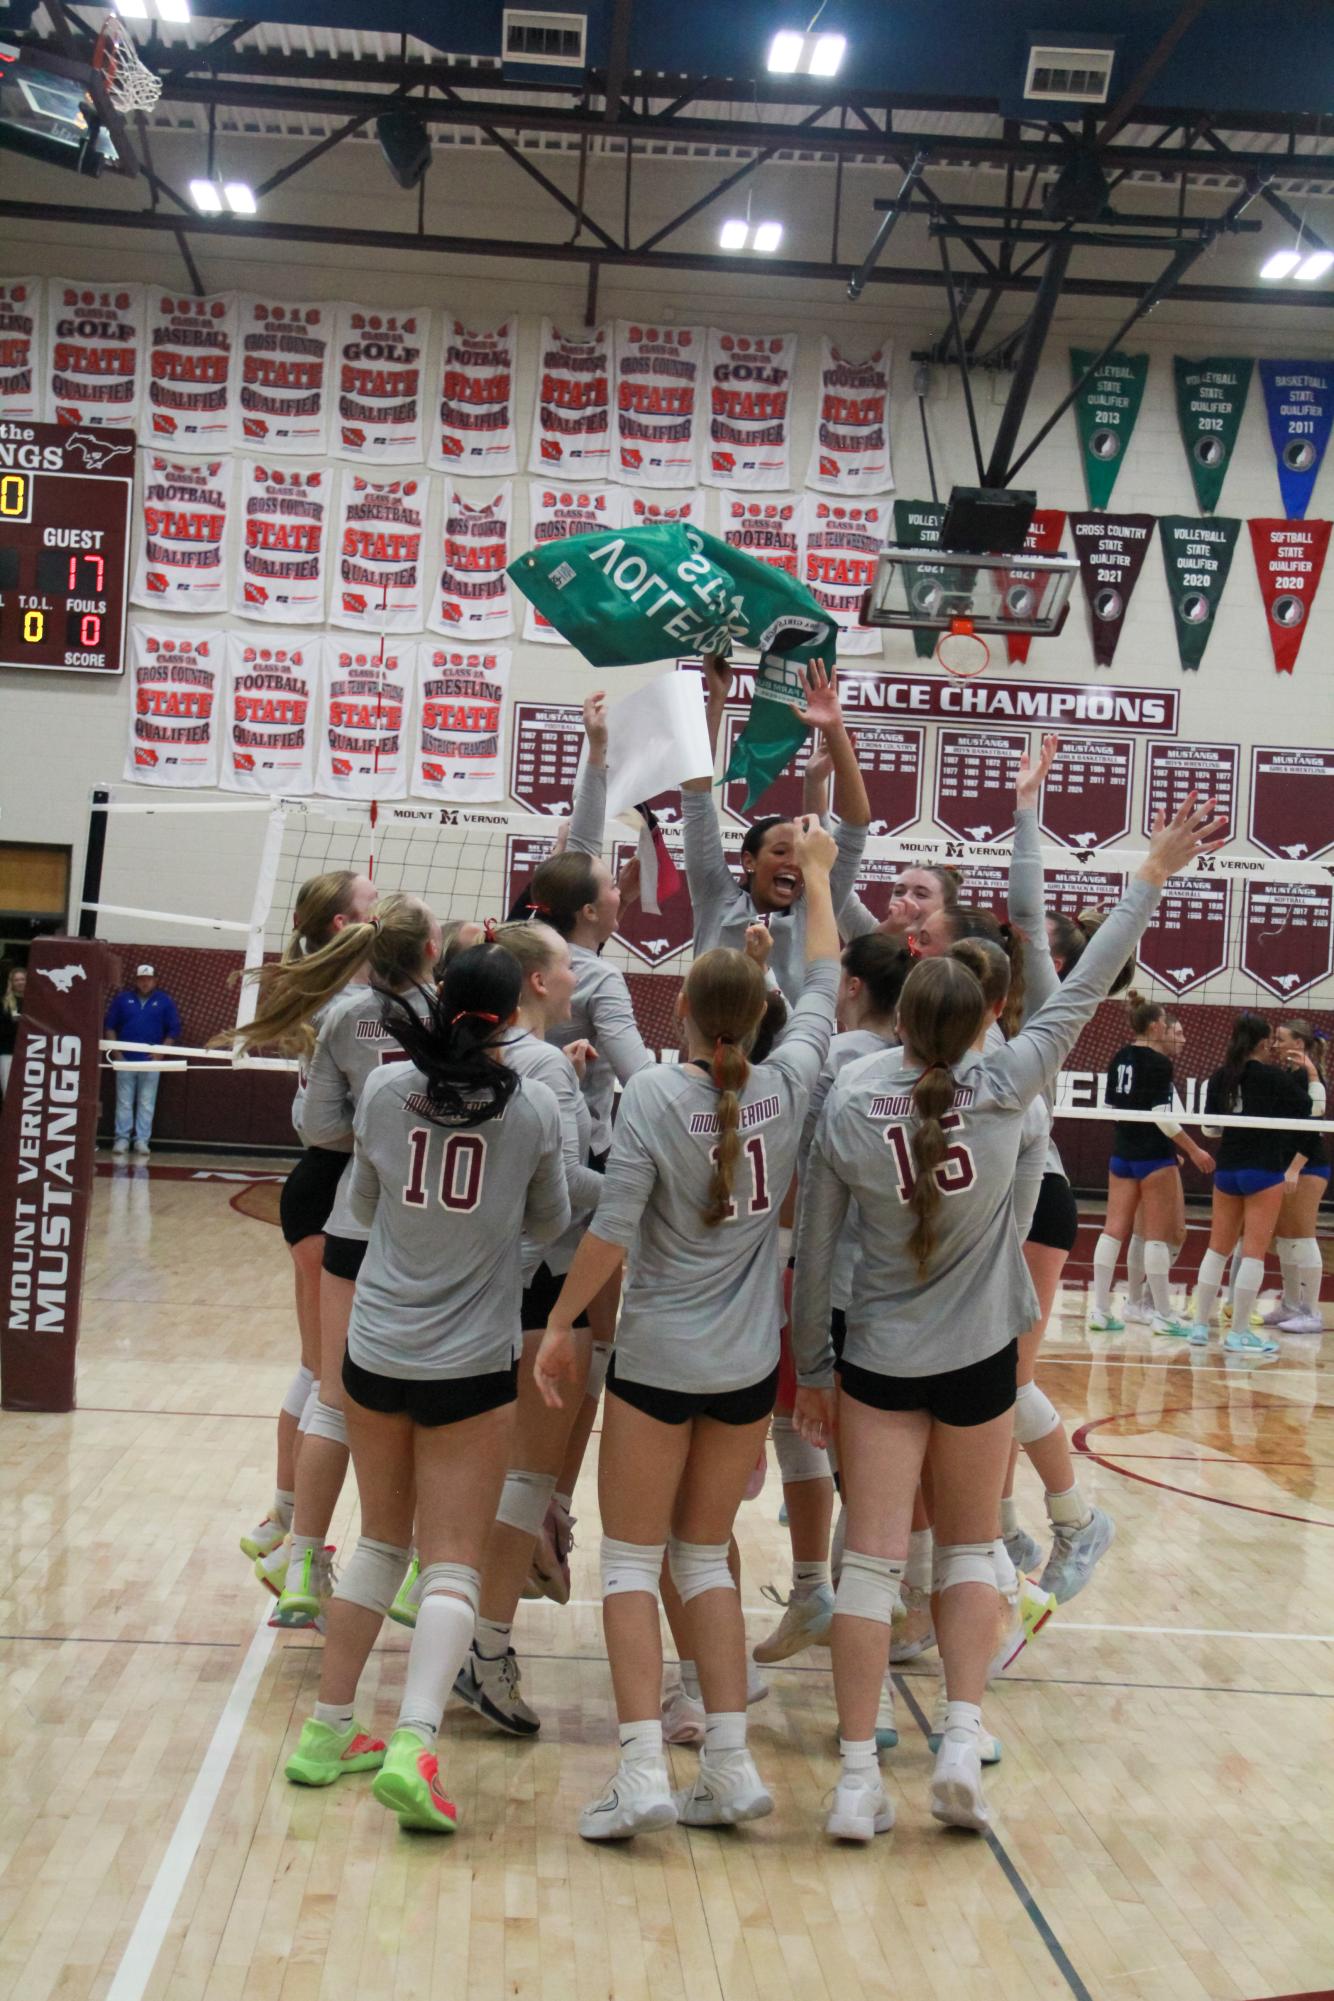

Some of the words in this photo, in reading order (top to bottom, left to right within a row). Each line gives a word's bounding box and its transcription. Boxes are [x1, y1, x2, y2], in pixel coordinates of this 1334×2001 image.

[56, 320, 136, 342] GOLF
[152, 328, 231, 353] BASEBALL
[54, 343, 136, 376] STATE
[342, 343, 420, 365] GOLF
[151, 351, 229, 383] STATE
[243, 355, 323, 389] STATE
[713, 364, 788, 386] GOLF
[52, 374, 135, 403] QUALIFIER
[340, 364, 419, 397] STATE
[443, 371, 511, 405] STATE
[1097, 381, 1121, 393] STATE
[1275, 376, 1328, 388] BASKETBALL
[150, 380, 227, 411] QUALIFIER
[240, 386, 320, 416] QUALIFIER
[541, 373, 608, 411] STATE
[618, 380, 695, 417] STATE
[1088, 395, 1129, 407] QUALIFIER
[1199, 387, 1224, 399] STATE
[1289, 391, 1314, 403] STATE
[339, 395, 417, 424] QUALIFIER
[711, 386, 788, 421] STATE
[822, 394, 885, 425] STATE
[1190, 401, 1232, 413] QUALIFIER
[1280, 404, 1322, 417] QUALIFIER
[540, 404, 608, 434] QUALIFIER
[1095, 411, 1120, 424] 2013
[1198, 418, 1223, 431] 2012
[1288, 421, 1314, 434] 2011
[0, 424, 35, 440] the
[618, 413, 692, 443] QUALIFIER
[710, 418, 784, 447] QUALIFIER
[147, 485, 226, 510] FOOTBALL
[543, 491, 606, 510] 2021
[346, 504, 422, 528] BASKETBALL
[554, 509, 582, 519] CLASS
[144, 507, 225, 543] STATE
[534, 521, 566, 540] CROSS
[742, 519, 767, 530] CLASS
[826, 520, 852, 531] CLASS
[1076, 524, 1105, 536] CROSS
[1107, 525, 1146, 539] COUNTRY
[43, 528, 104, 549] GUEST
[246, 519, 322, 554] STATE
[343, 527, 421, 562] STATE
[725, 530, 798, 550] FOOTBALL
[1174, 528, 1226, 542] VOLLEYBALL
[1270, 532, 1313, 544] SOFTBALL
[146, 540, 220, 569] QUALIFIER
[444, 537, 507, 572] STATE
[1099, 540, 1123, 552] STATE
[1186, 544, 1210, 556] STATE
[1277, 547, 1304, 558] STATE
[244, 550, 319, 580] QUALIFIER
[1090, 554, 1131, 566] QUALIFIER
[1177, 558, 1218, 571] QUALIFIER
[1269, 561, 1312, 572] QUALIFIER
[69, 555, 104, 592] 17
[341, 559, 416, 589] QUALIFIER
[1097, 569, 1122, 582] 2021
[1183, 574, 1211, 587] 2020
[1275, 577, 1304, 589] 2020
[19, 595, 53, 610] T.O.L.
[66, 598, 106, 613] FOULS
[23, 611, 44, 642] 0
[81, 614, 100, 646] 0
[64, 652, 105, 667] SCORE
[156, 654, 183, 665] CLASS
[243, 647, 303, 666] 2024
[432, 651, 497, 670] 2025
[137, 666, 168, 684] CROSS
[171, 666, 215, 690] COUNTRY
[253, 664, 278, 673] CLASS
[348, 669, 374, 679] CLASS
[442, 668, 471, 678] CLASS
[234, 674, 309, 698] FOOTBALL
[424, 679, 502, 702] WRESTLING
[136, 687, 214, 719] STATE
[233, 695, 308, 725] STATE
[940, 687, 1165, 723] CHAMPIONS
[329, 701, 402, 731] STATE
[422, 702, 500, 733] STATE
[135, 718, 210, 744] QUALIFIER
[232, 724, 305, 750] QUALIFIER
[958, 738, 1009, 748] MUSTANGS
[1063, 744, 1114, 754] MUSTANGS
[1168, 750, 1218, 760] MUSTANGS
[1184, 761, 1220, 769] WRESTLING
[1272, 756, 1324, 766] MUSTANGS
[394, 810, 433, 820] MOUNT
[463, 815, 509, 825] VERNON
[900, 843, 939, 852] MOUNT
[969, 847, 1012, 856] VERNON
[1220, 861, 1265, 870] VERNON
[1055, 874, 1107, 884] MUSTANGS
[1265, 886, 1316, 897] MUSTANGS
[17, 1034, 48, 1184] VERNON
[883, 1110, 978, 1204] 15
[402, 1127, 487, 1213] 10
[34, 1035, 82, 1333] MUSTANGS
[8, 1199, 35, 1331] MOUNT
